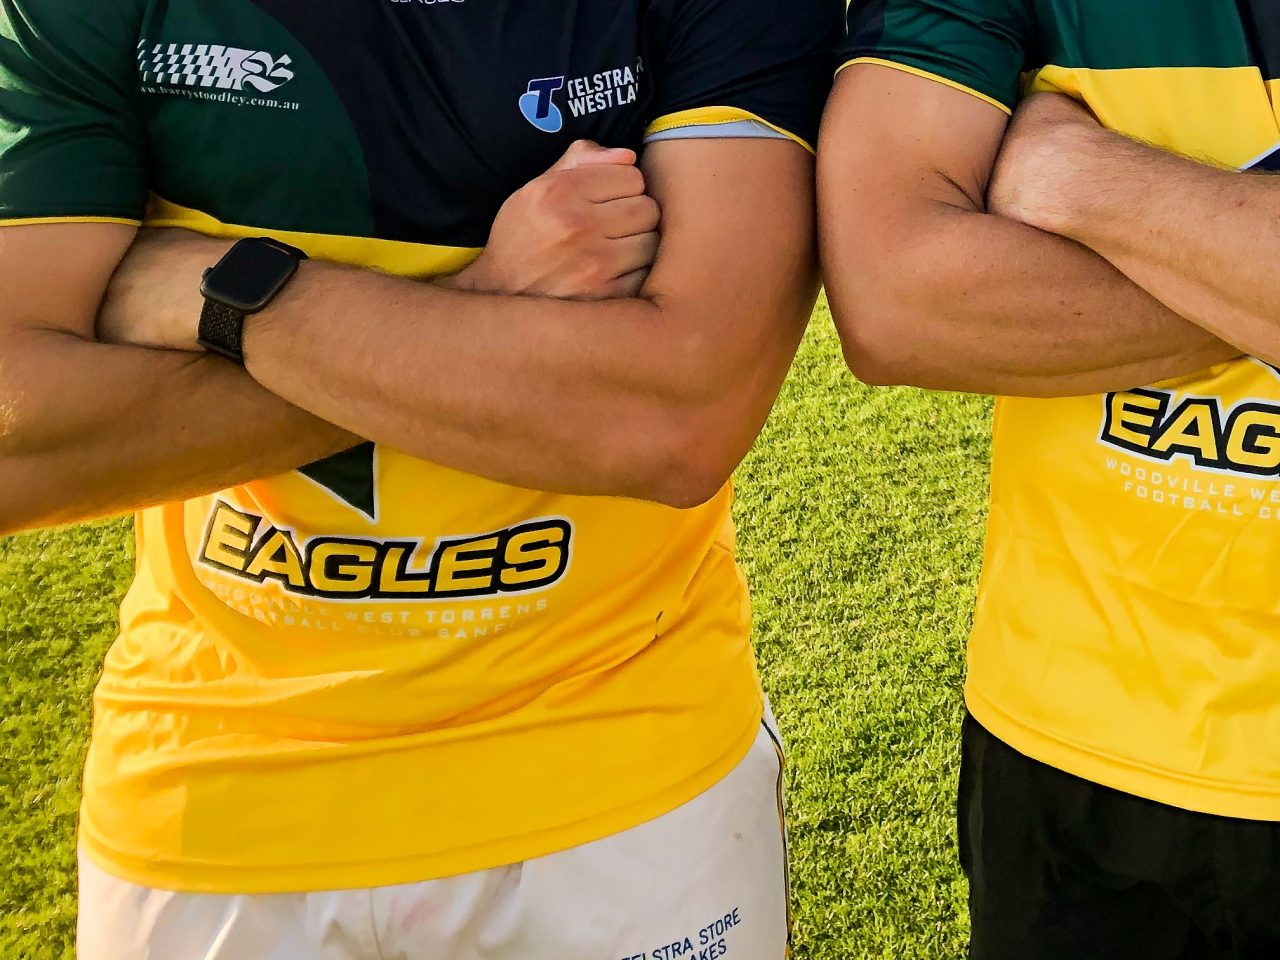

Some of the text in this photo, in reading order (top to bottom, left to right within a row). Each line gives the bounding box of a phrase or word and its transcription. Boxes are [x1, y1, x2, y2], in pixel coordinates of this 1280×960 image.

[567, 66, 635, 99] TELSTRA
[567, 88, 614, 118] WEST
[1106, 456, 1236, 498] WOODVILLE
[1123, 481, 1244, 516] FOOTBALL
[198, 500, 574, 600] EAGLES
[344, 610, 411, 624] WEST
[425, 598, 548, 624] TORRENS
[698, 906, 741, 946] STORE
